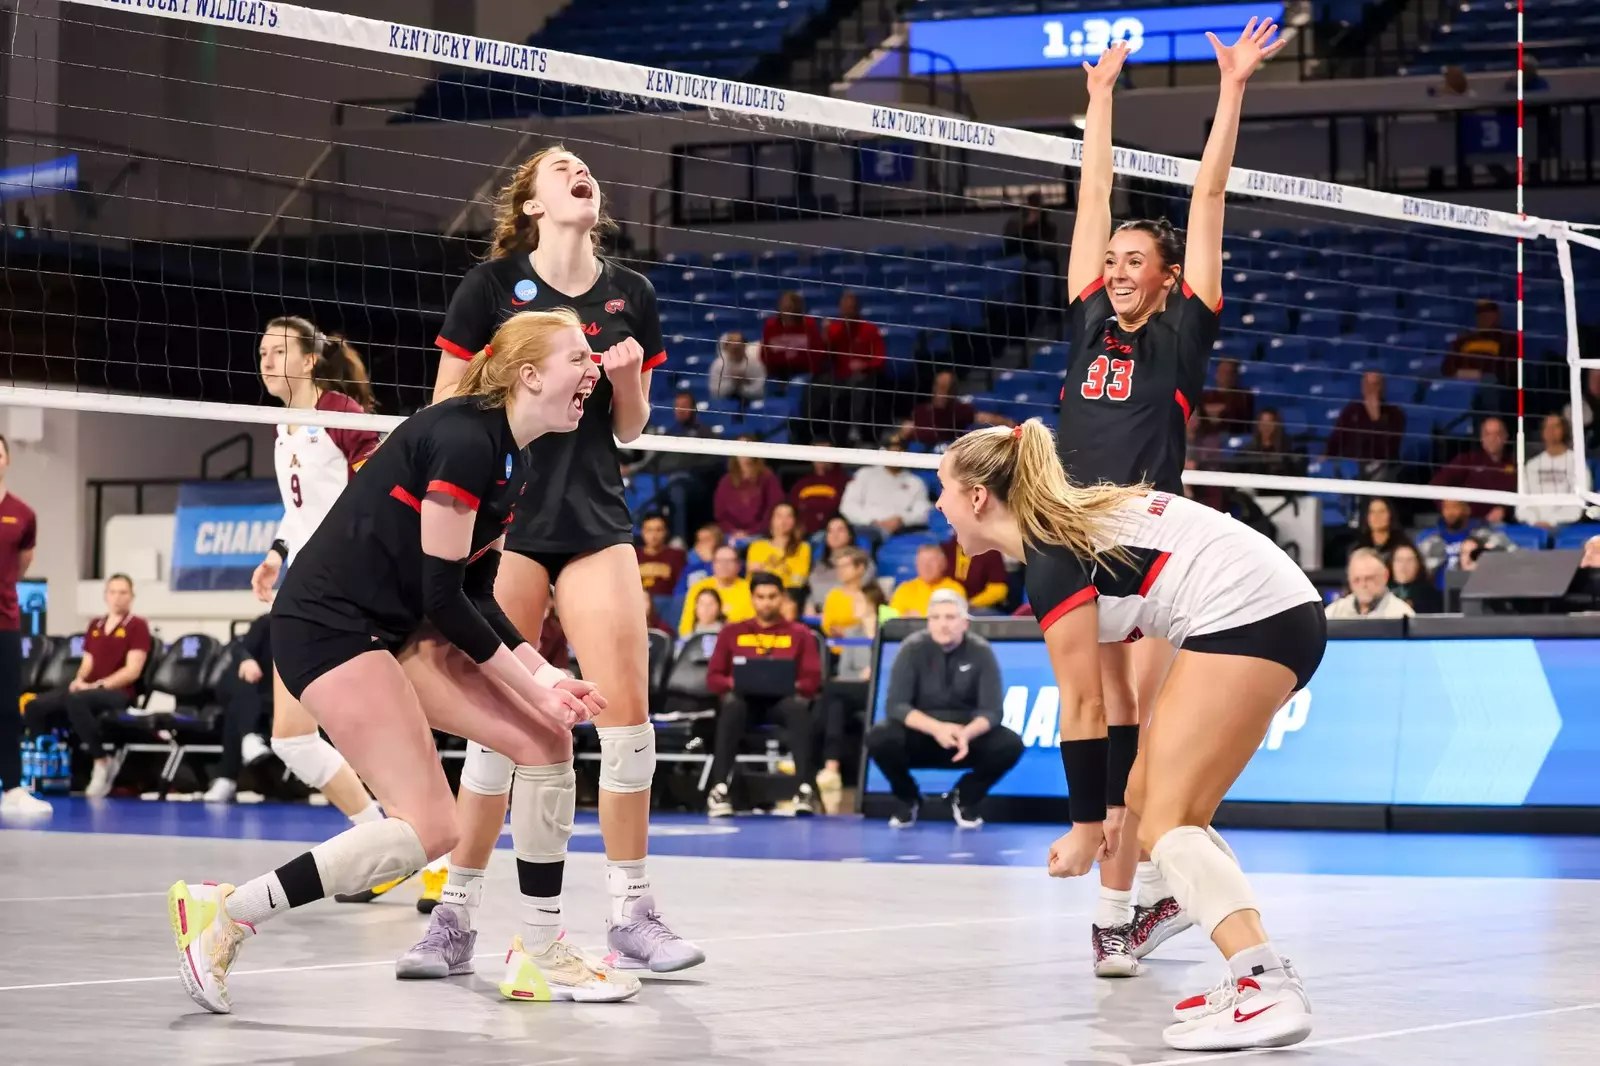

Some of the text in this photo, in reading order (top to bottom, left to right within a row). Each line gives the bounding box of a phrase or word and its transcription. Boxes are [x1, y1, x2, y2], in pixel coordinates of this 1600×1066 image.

[195, 0, 280, 28] WILDCATS
[389, 25, 548, 73] KENTUCKY WILDCATS
[646, 70, 786, 112] KENTUCKY WILDCATS
[872, 108, 996, 146] KENTUCKY WILDCATS
[1129, 152, 1180, 177] WILDCATS
[1081, 354, 1135, 401] 33
[290, 473, 303, 508] 9
